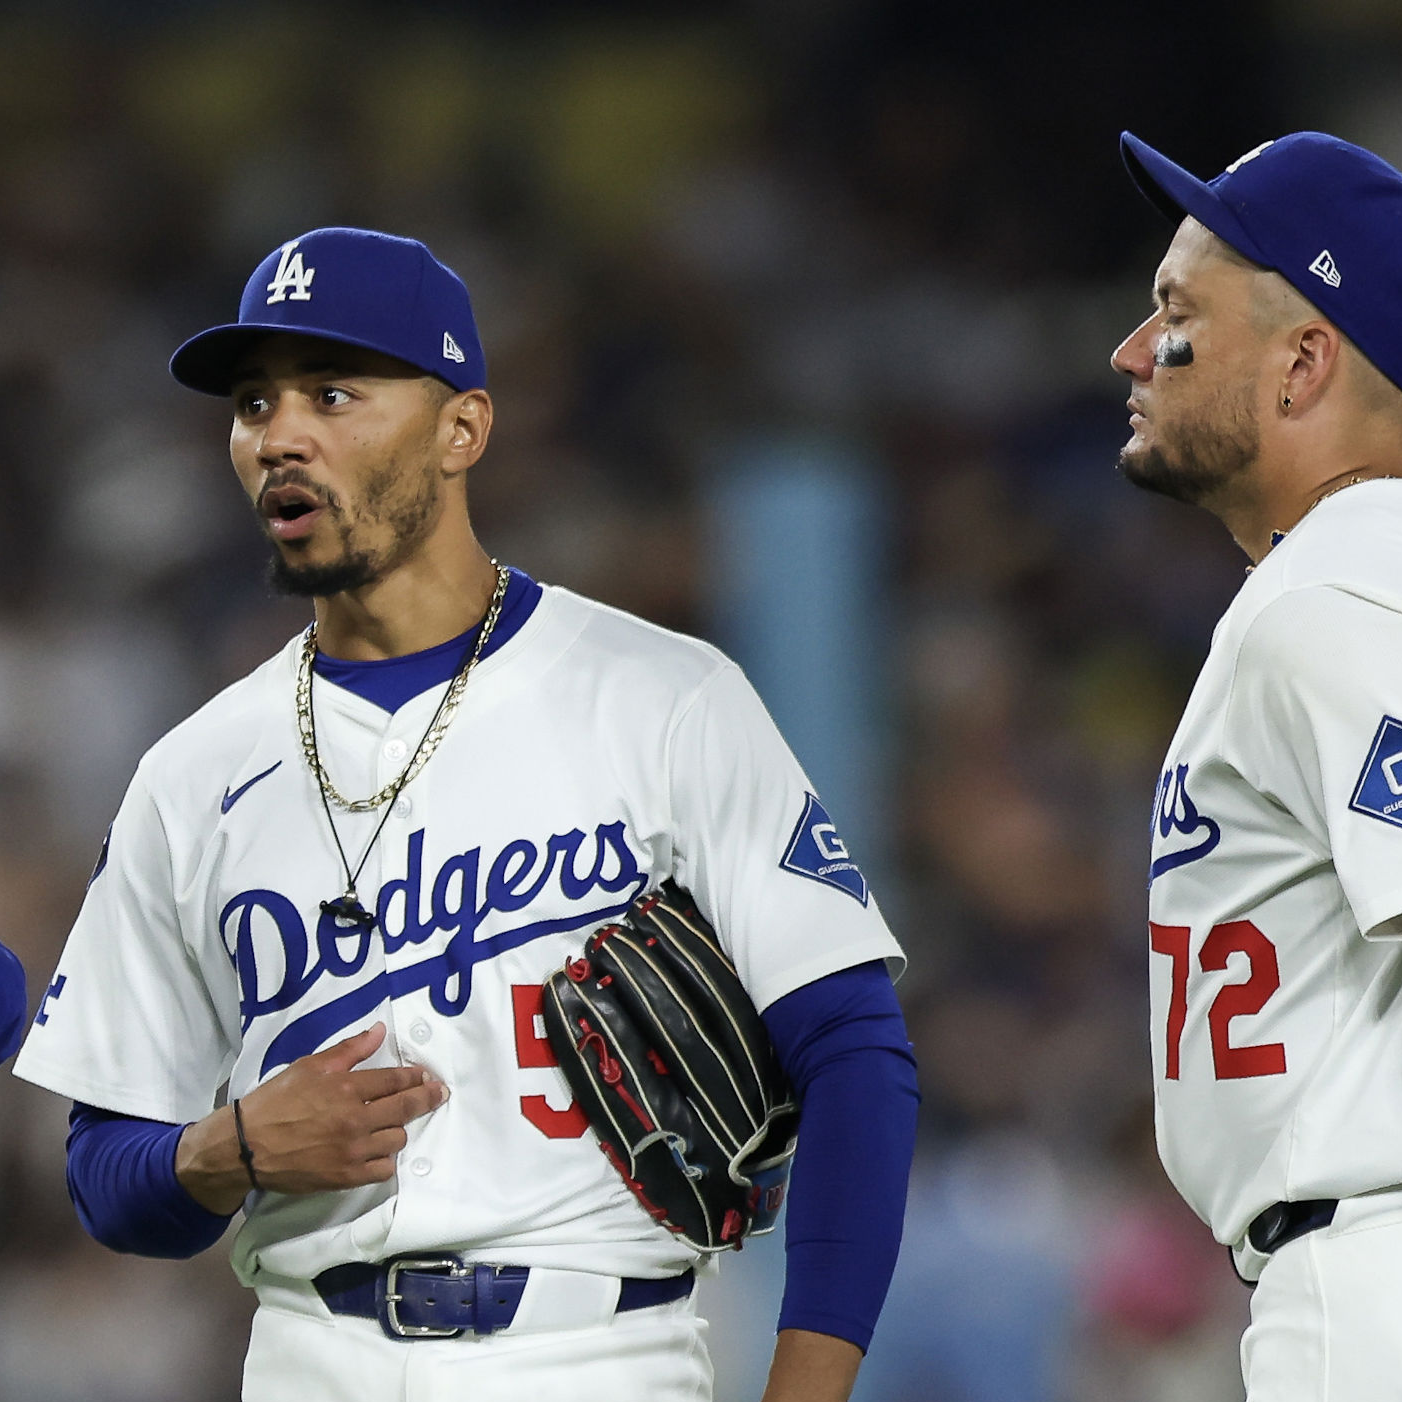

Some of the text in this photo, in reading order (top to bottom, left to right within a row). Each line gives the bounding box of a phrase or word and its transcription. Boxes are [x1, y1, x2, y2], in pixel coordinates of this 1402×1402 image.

[267, 241, 315, 305] LA
[219, 820, 649, 1038] Dodgers
[1148, 919, 1287, 1080] 72
